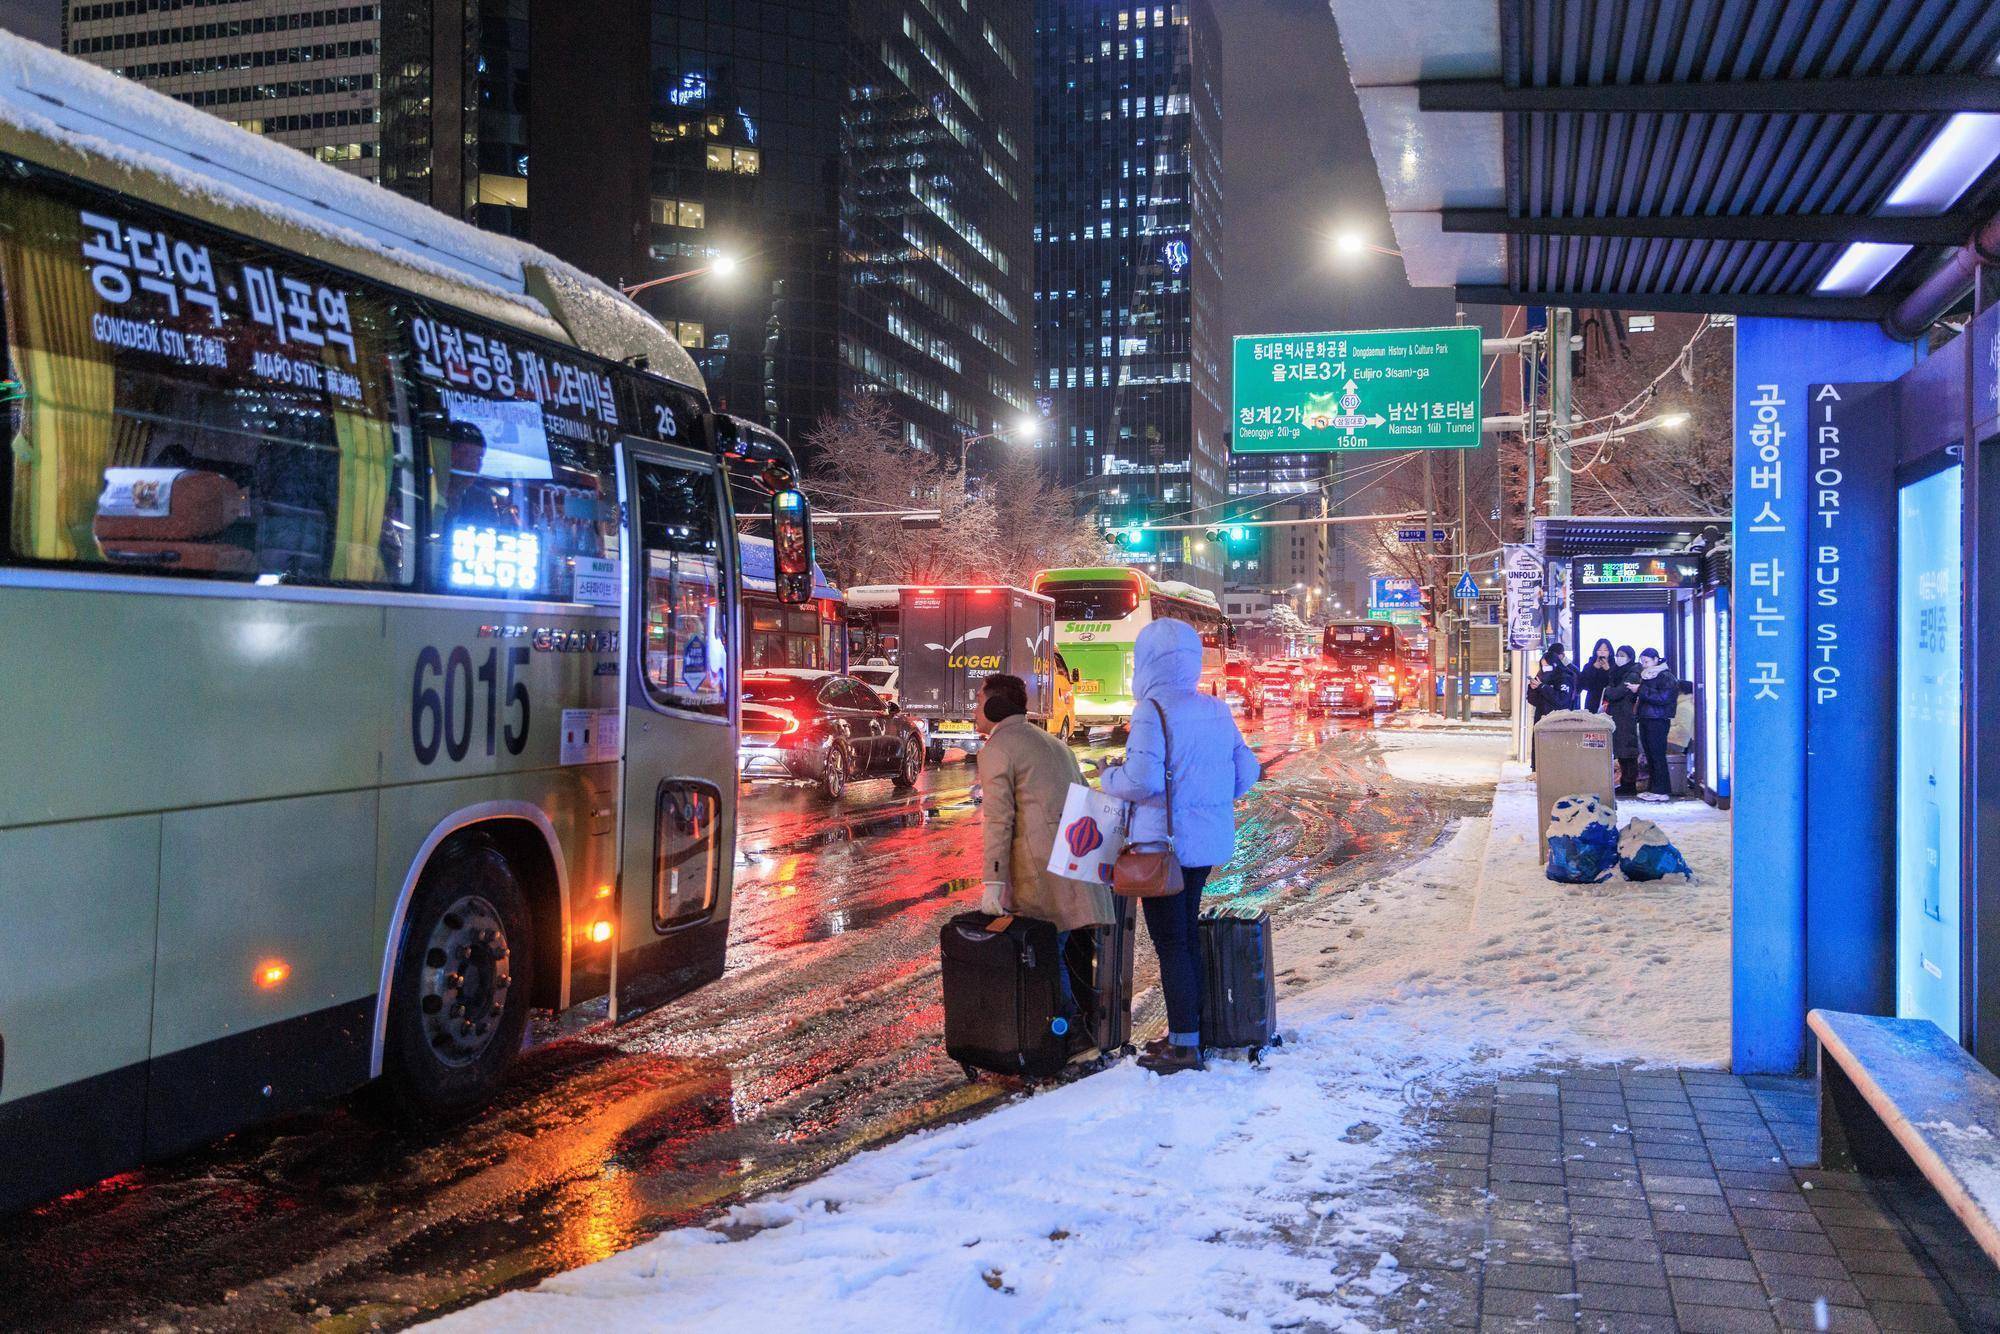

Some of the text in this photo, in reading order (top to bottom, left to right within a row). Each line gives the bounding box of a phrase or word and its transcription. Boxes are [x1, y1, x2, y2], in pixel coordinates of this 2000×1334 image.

[92, 313, 190, 360] GONGDEOK STN.
[412, 317, 516, 397] 인천공항
[1253, 340, 1347, 360] 동대문역사문화공원
[1352, 344, 1448, 358] Dongdaemun History & Culture Park
[254, 351, 322, 391] MAPO STN.
[1271, 361, 1347, 382] 을지로3가
[1353, 366, 1430, 380] Euljiro 3(sam)-ga
[1344, 397, 1356, 407] 60
[655, 404, 677, 437] 26
[1388, 424, 1422, 435] Namsan
[1446, 422, 1475, 433] Tunnel
[1239, 427, 1274, 439] Cheonggye
[1337, 436, 1368, 448] 150m
[1814, 384, 1843, 528] AIRPORT
[1749, 384, 1786, 701] 공항버스 타는 곳
[592, 561, 614, 573] NAVER
[1508, 571, 1536, 579] UNFOLD
[1816, 546, 1840, 606] BUS
[1064, 621, 1112, 633] Sunin
[948, 655, 1001, 669] LOGEN
[412, 645, 531, 766] 6015
